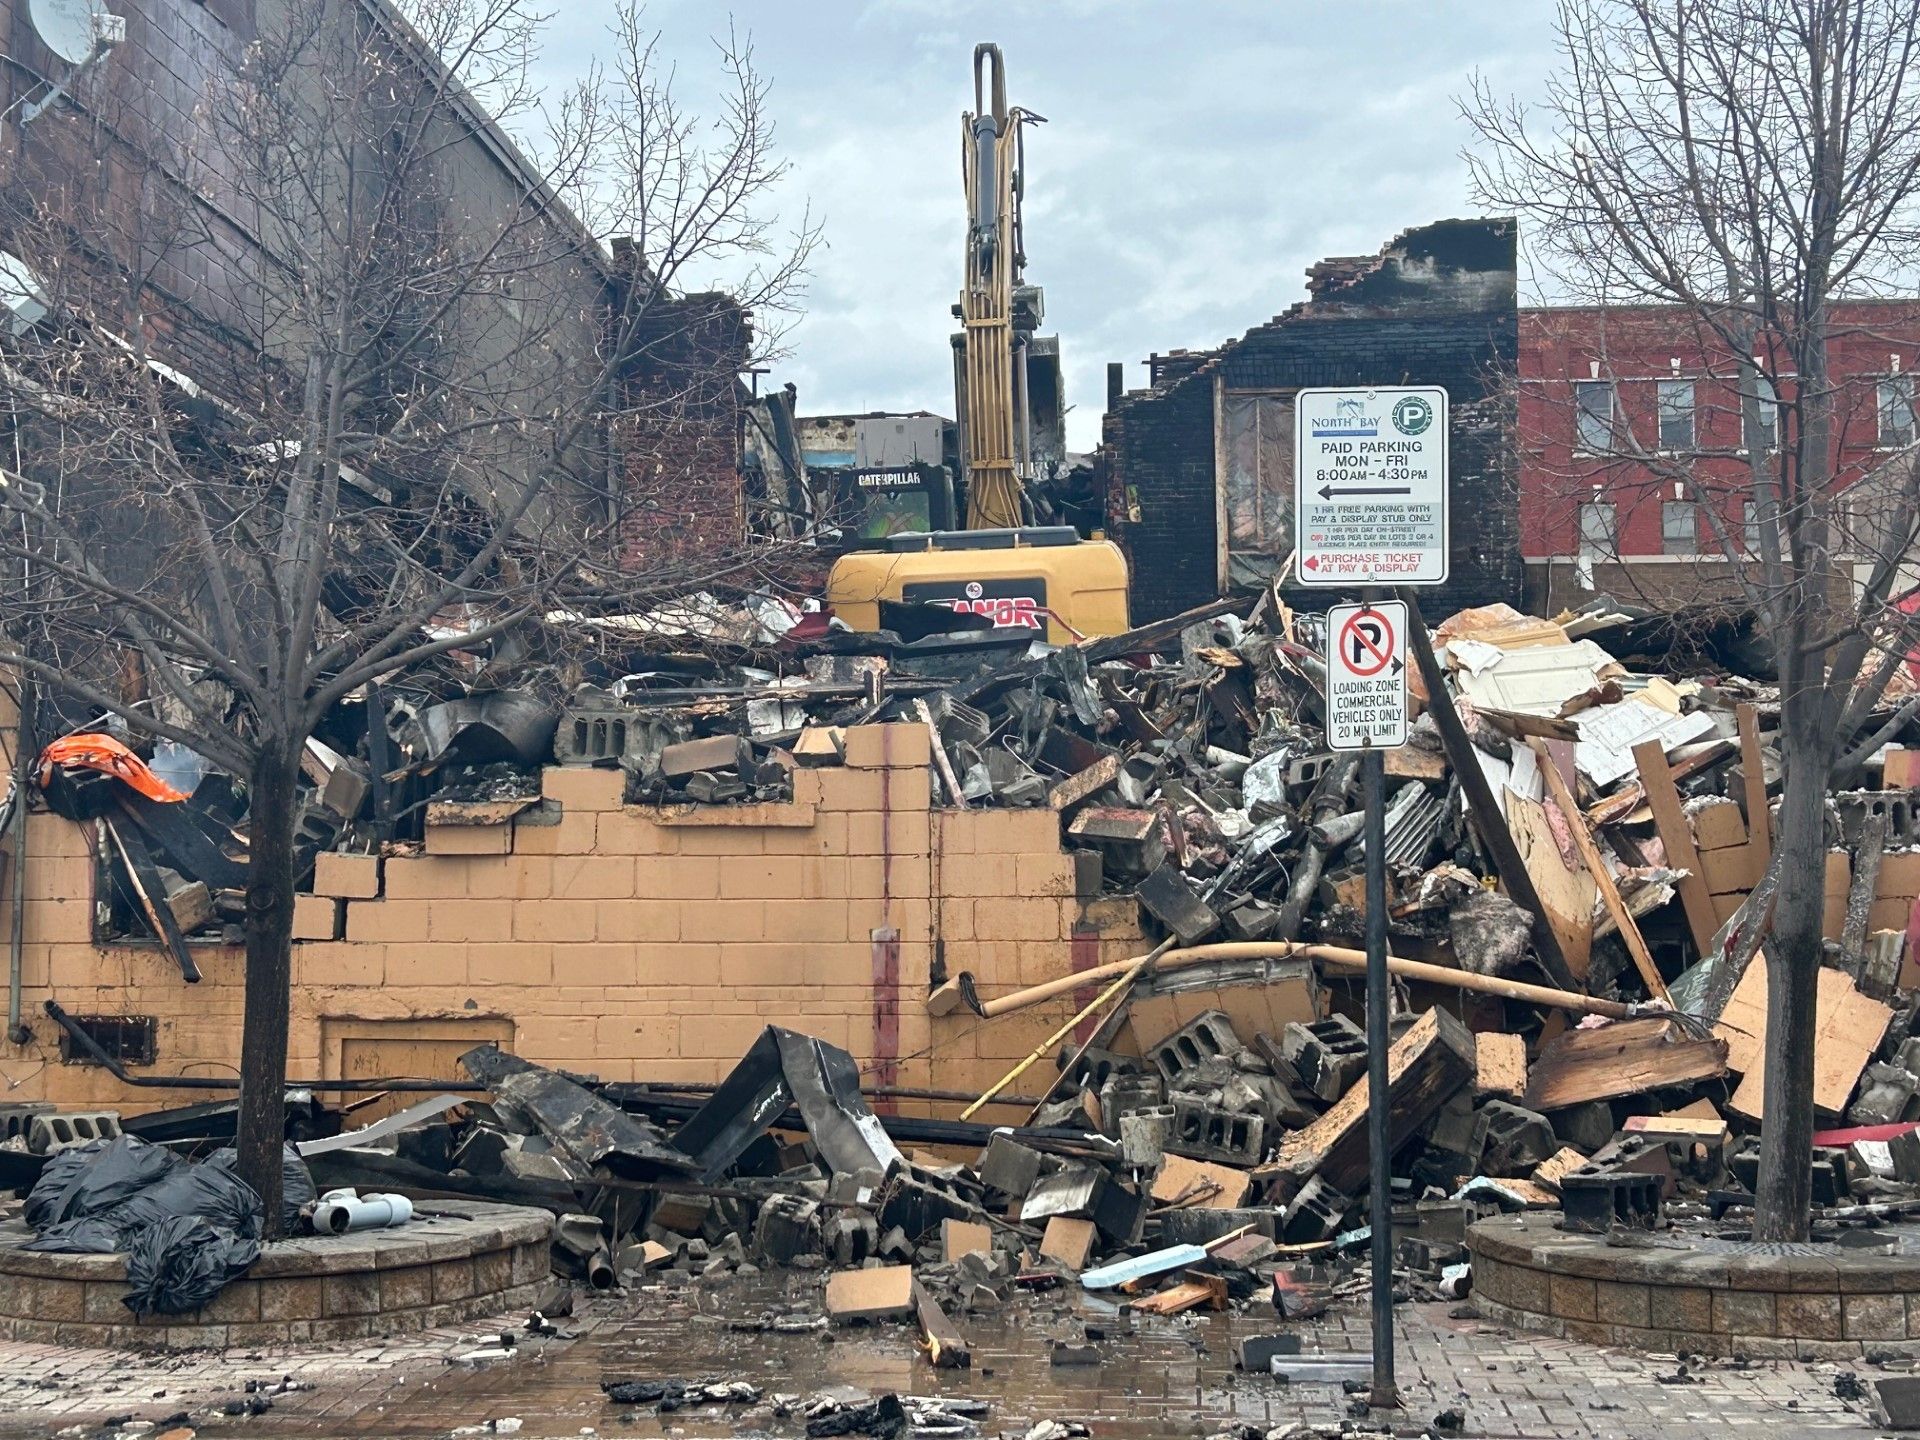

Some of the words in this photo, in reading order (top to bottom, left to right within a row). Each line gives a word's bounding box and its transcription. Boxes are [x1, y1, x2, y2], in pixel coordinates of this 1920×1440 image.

[1312, 418, 1352, 428] NORTH
[1360, 416, 1381, 427] BAY
[1321, 442, 1353, 453] PAID
[1360, 441, 1423, 453] PARKING
[1335, 455, 1369, 467] MON
[1386, 455, 1408, 466] FRI
[858, 472, 921, 486] CATERPILLAR
[1338, 505, 1360, 513] FREE
[1364, 505, 1404, 513] PARKING
[1407, 504, 1430, 512] WITH
[1311, 515, 1327, 523] PAY
[1331, 515, 1337, 523] &
[1341, 515, 1377, 523] DISPLAY
[1382, 514, 1405, 522] STUB
[1409, 514, 1432, 522] ONLY
[1320, 554, 1379, 563] PURCHASE
[1383, 553, 1423, 562] TICKET
[1321, 564, 1334, 573] AT
[1339, 564, 1357, 573] PAY
[1362, 564, 1369, 572] &
[1375, 563, 1420, 572] DISPLAY
[1333, 681, 1372, 695] LOADING
[1376, 679, 1401, 692] ZONE
[1337, 695, 1397, 709] COMMERCIAL
[1333, 710, 1376, 724] VEHICLES
[1380, 708, 1402, 721] ONLY
[1338, 727, 1350, 738] 20
[1353, 725, 1370, 737] MIN
[1374, 724, 1397, 736] LIMIT
